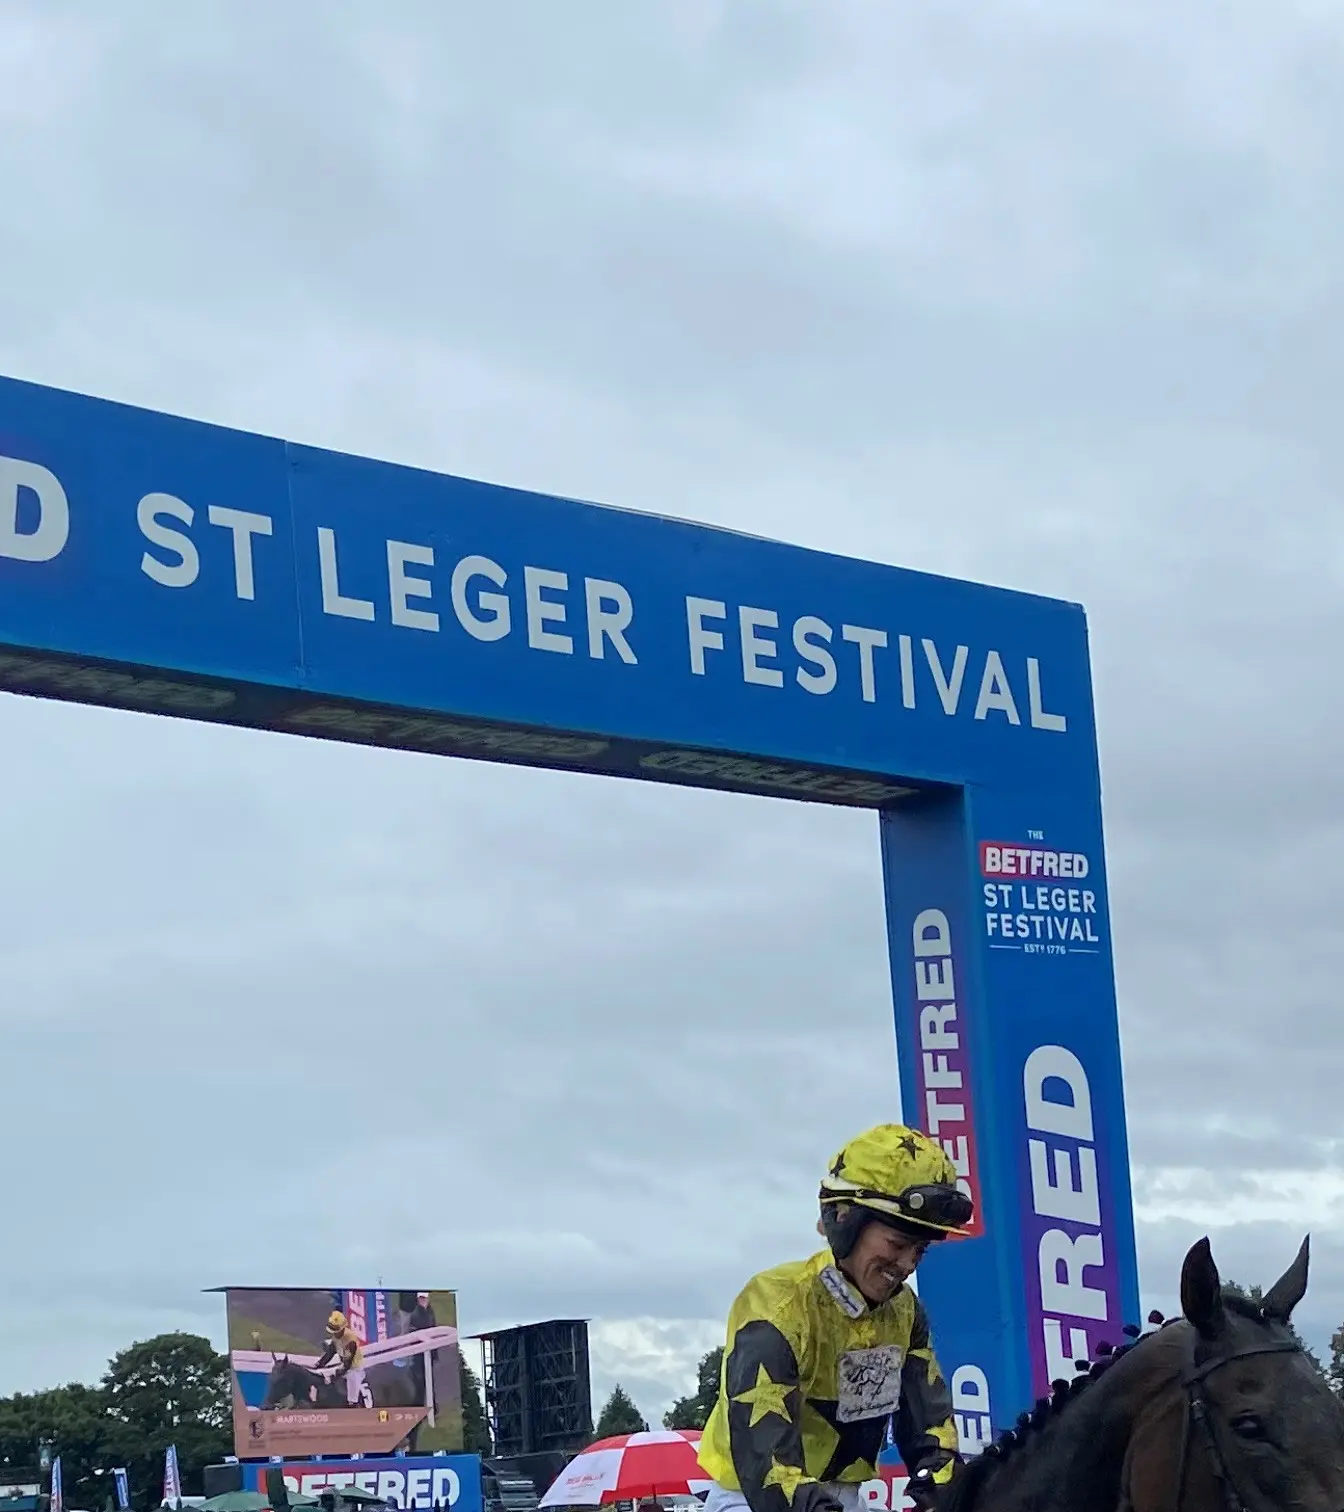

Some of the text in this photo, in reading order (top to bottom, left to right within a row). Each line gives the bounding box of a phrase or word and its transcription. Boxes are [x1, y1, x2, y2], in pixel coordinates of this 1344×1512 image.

[136, 492, 272, 601] ST
[316, 527, 638, 665] LEGER
[686, 596, 1066, 732] FESTIVAL
[1028, 830, 1044, 840] THE
[985, 847, 1089, 878] BETFRED
[983, 883, 1097, 914] ST LEGER
[986, 912, 1099, 942] FESTIVAL
[1046, 945, 1066, 955] 1776
[1023, 1044, 1109, 1390] FRED
